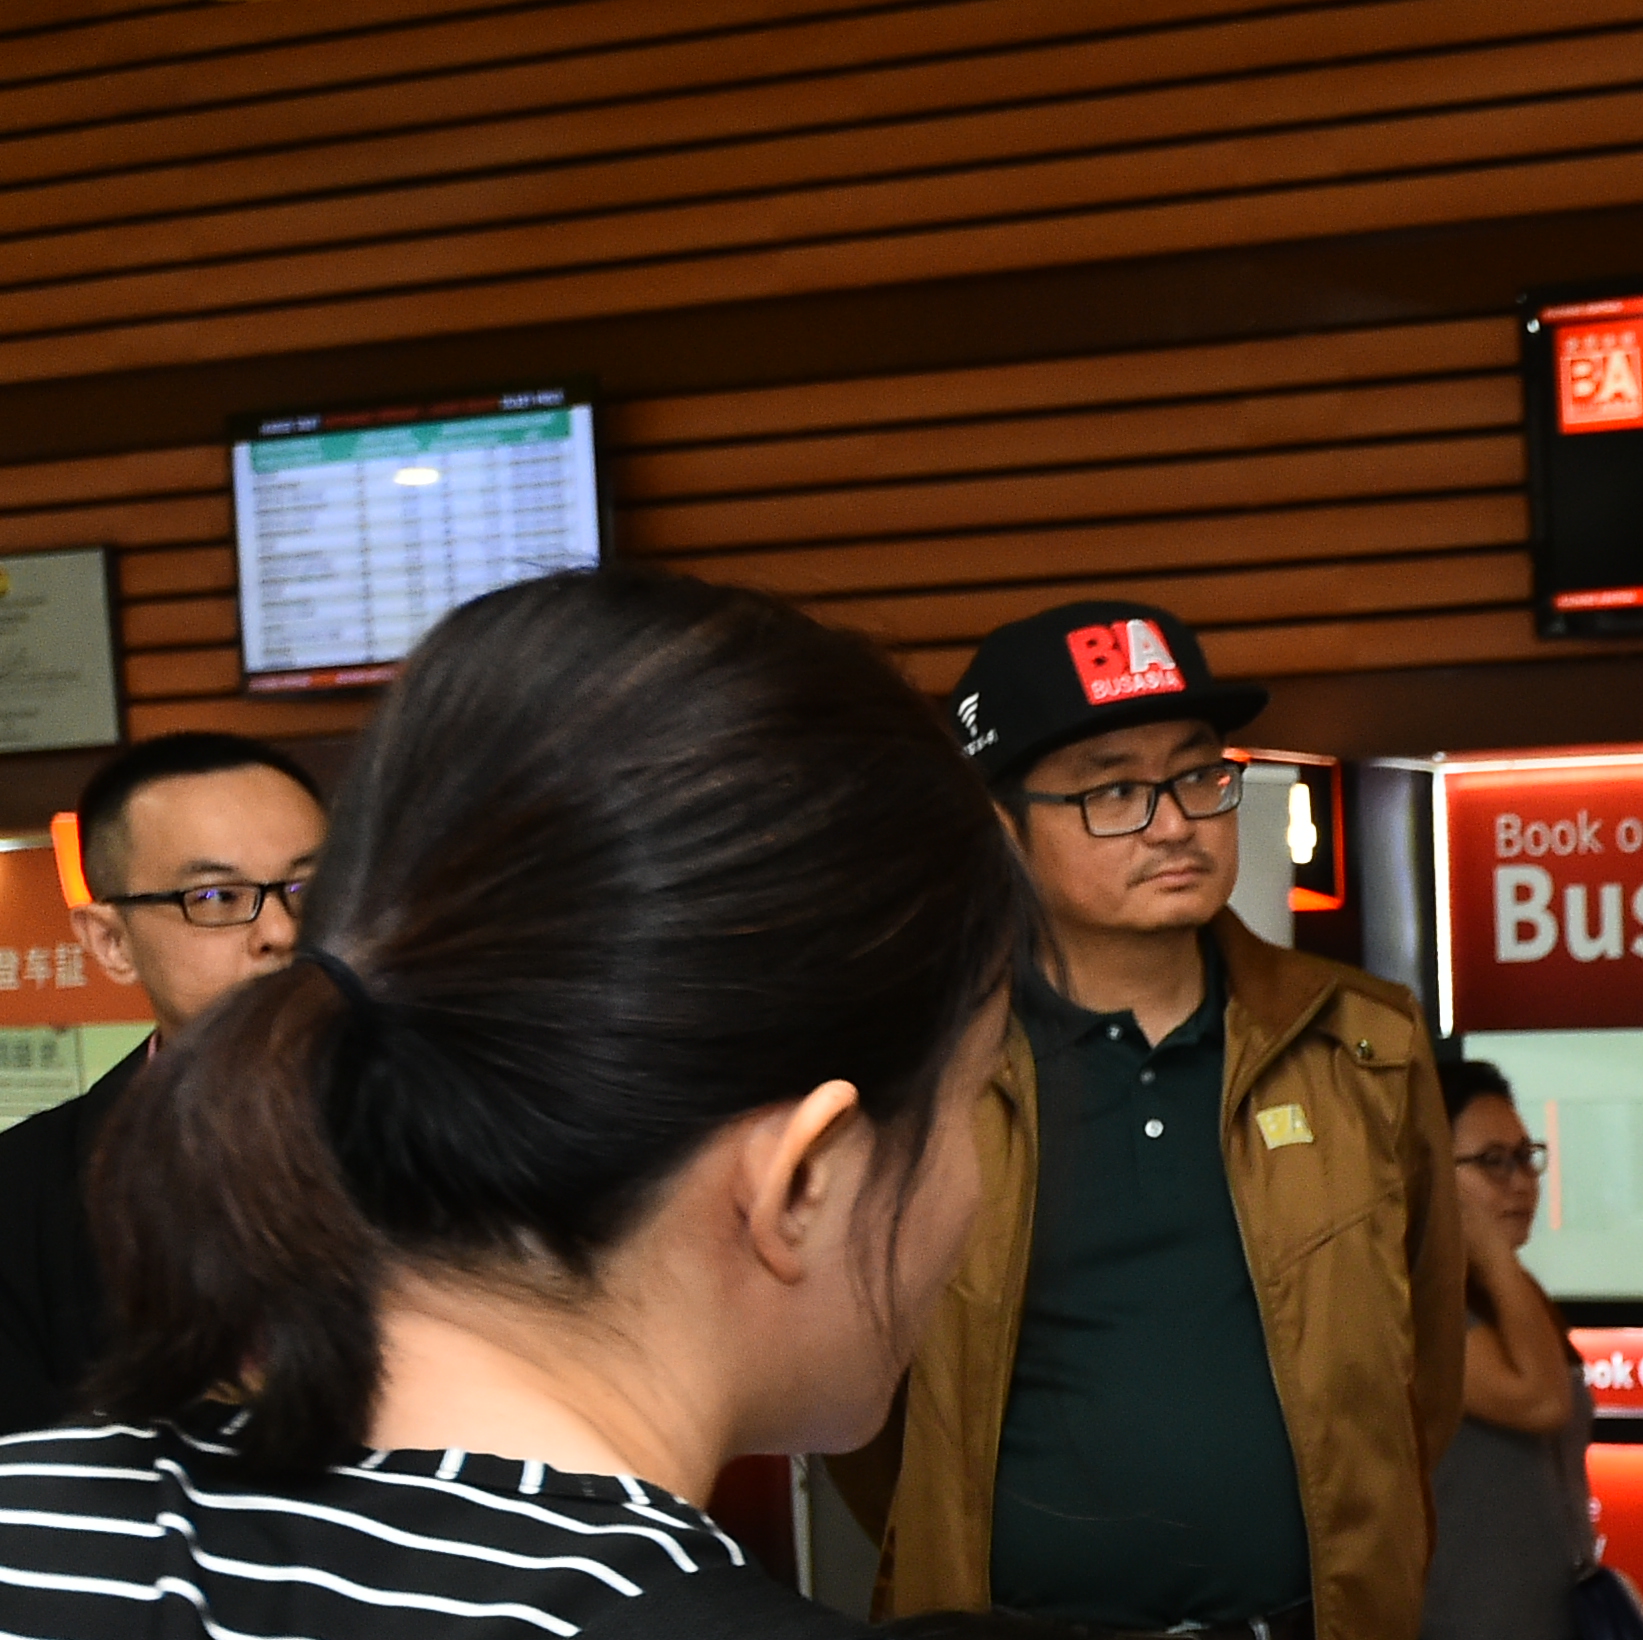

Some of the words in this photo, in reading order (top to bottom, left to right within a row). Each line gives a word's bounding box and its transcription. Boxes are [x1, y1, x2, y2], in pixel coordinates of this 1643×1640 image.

[1091, 670, 1181, 700] BUSASIA
[1495, 810, 1603, 857] Book
[1585, 1351, 1635, 1390] ook
